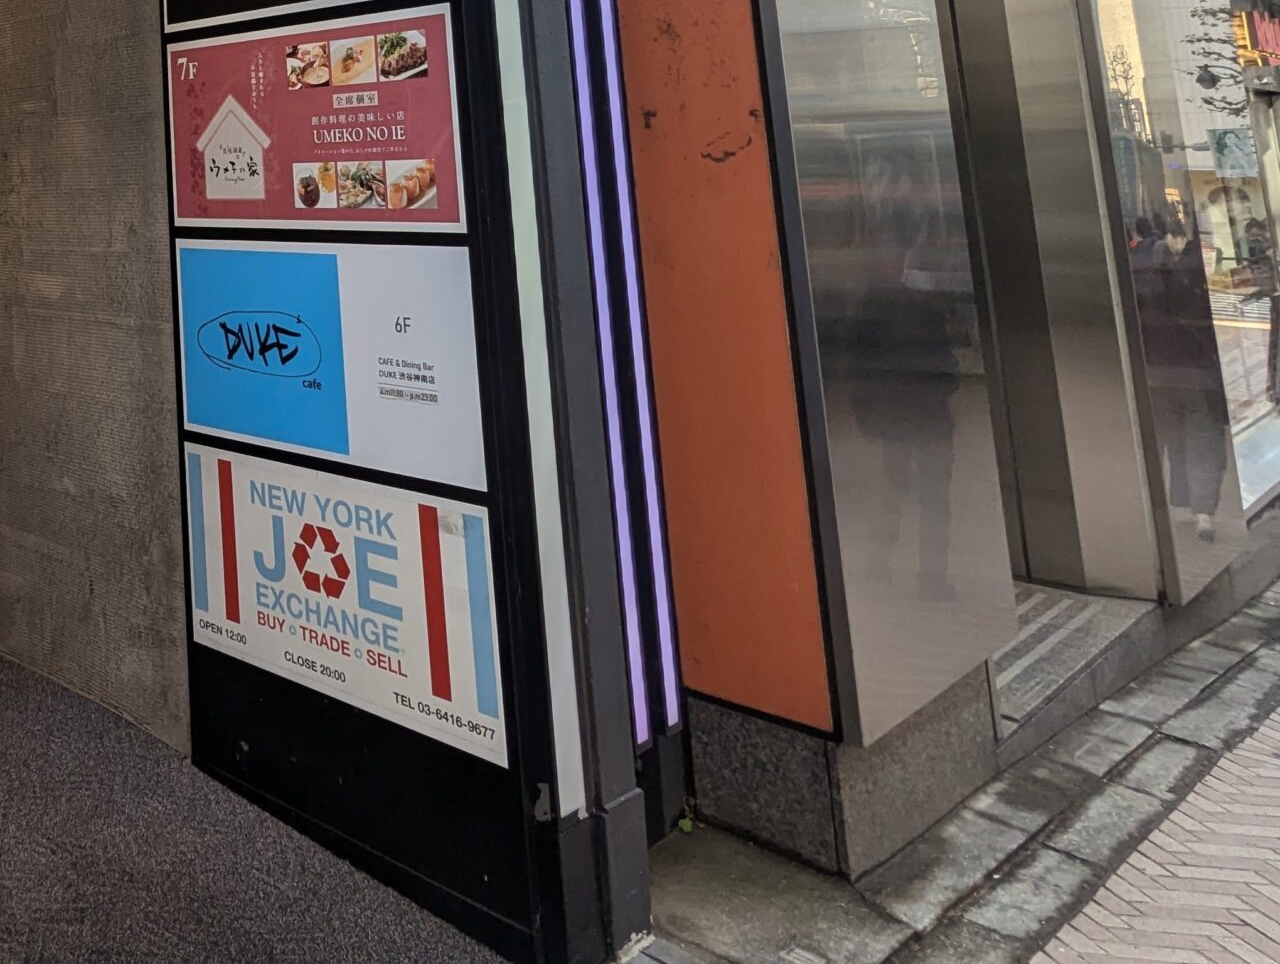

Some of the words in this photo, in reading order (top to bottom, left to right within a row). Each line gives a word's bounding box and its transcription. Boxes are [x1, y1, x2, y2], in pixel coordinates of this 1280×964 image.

[177, 57, 198, 81] 7F
[335, 93, 377, 107] 全席個室
[311, 110, 406, 126] 創作料理の美味しい店
[313, 127, 363, 144] UMEKO
[366, 126, 388, 140] NO
[392, 125, 406, 140] IE
[394, 316, 411, 334] 6F
[219, 322, 302, 367] DUKE
[378, 357, 394, 367] CAFE
[401, 360, 421, 372] Dining
[422, 362, 434, 371] Bar
[378, 370, 398, 379] DUKE
[302, 379, 322, 391] cafe
[250, 480, 306, 516] NEW
[314, 495, 397, 540] YORK
[255, 582, 401, 654] EXCHANGE
[199, 619, 223, 636] OPEN
[224, 629, 247, 645] 12:00
[257, 611, 286, 634] BUY
[299, 625, 351, 657] TRADE
[366, 649, 408, 678] SELL
[284, 651, 318, 673] CLOSE
[320, 665, 346, 683] 20:00
[393, 692, 415, 710] TEL
[417, 701, 496, 741] 03-6416-9677
